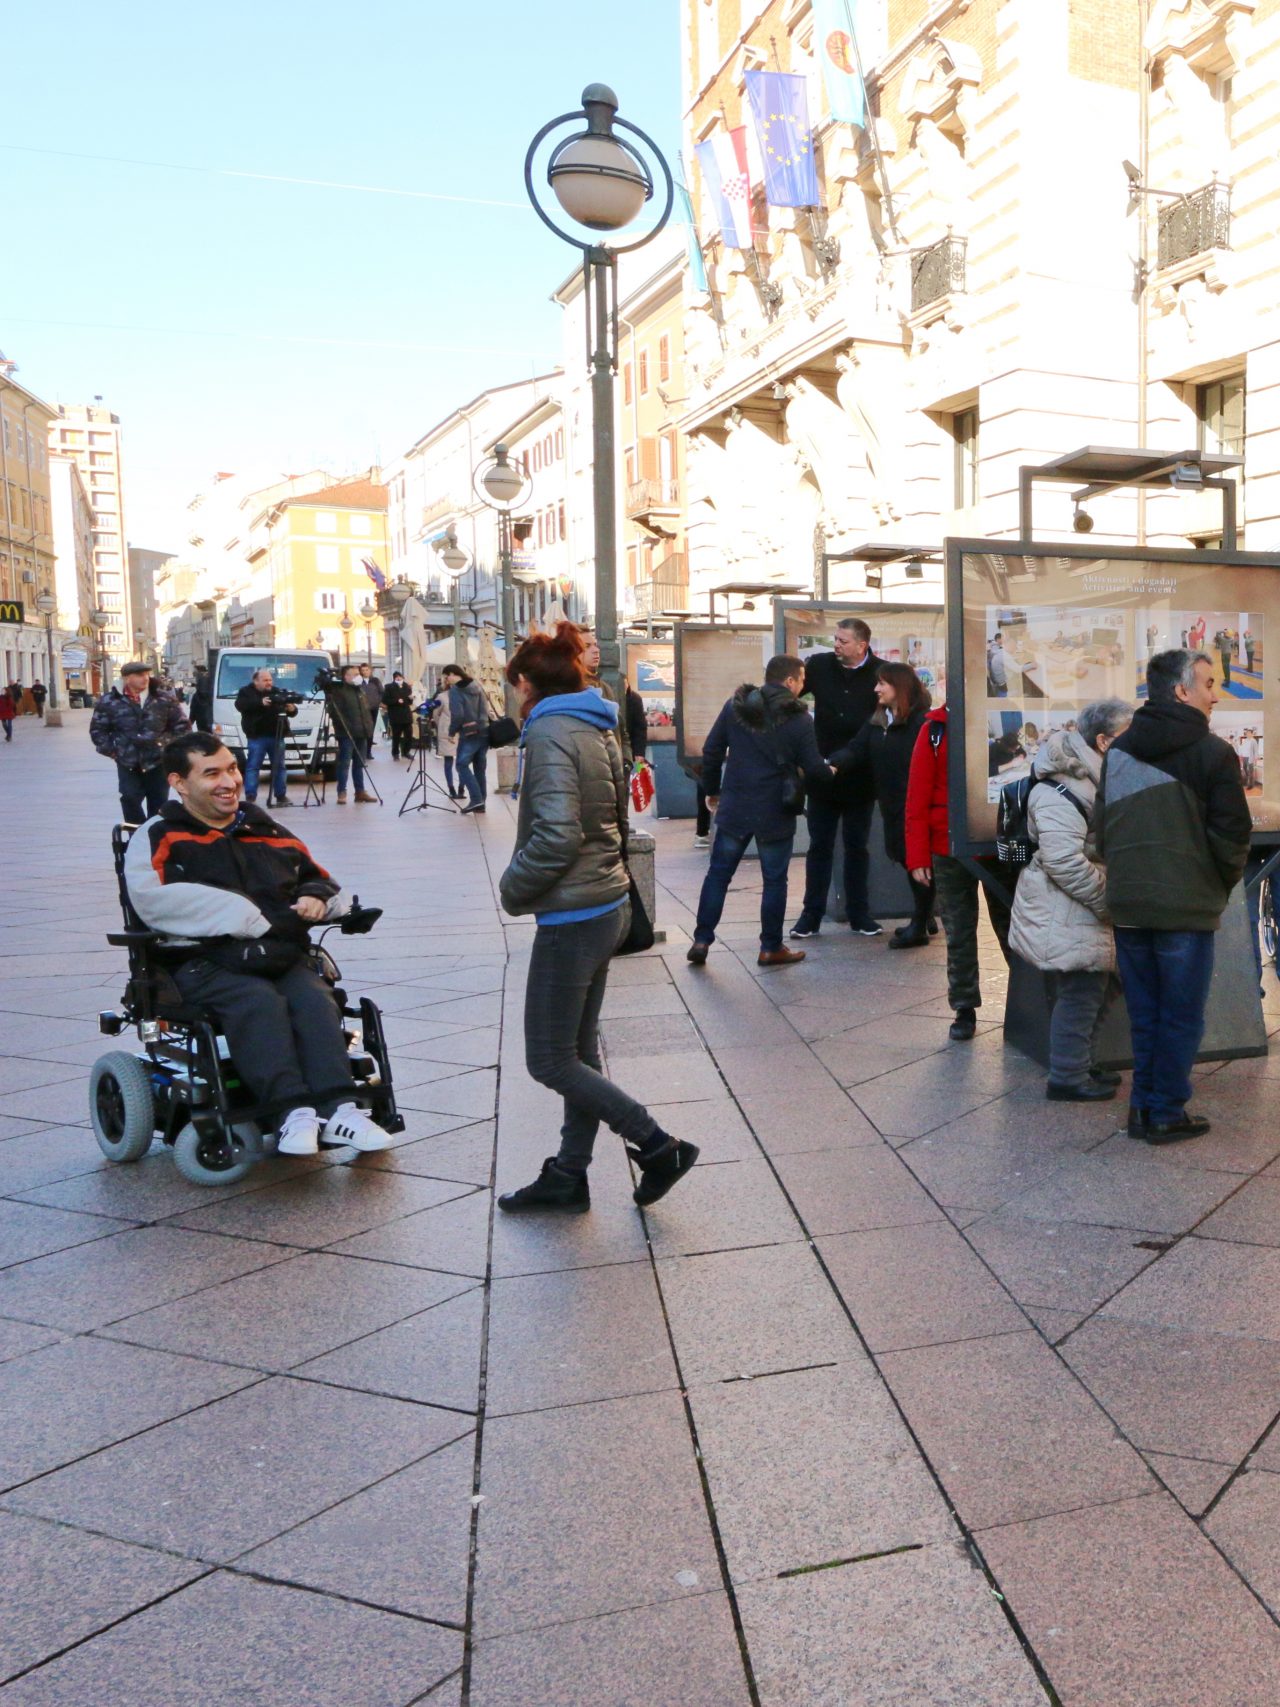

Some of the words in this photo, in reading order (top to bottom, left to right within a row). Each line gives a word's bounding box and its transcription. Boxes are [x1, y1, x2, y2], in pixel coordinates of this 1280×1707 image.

[1083, 583, 1127, 593] Activities
[1129, 584, 1145, 593] and
[1148, 586, 1177, 594] events
